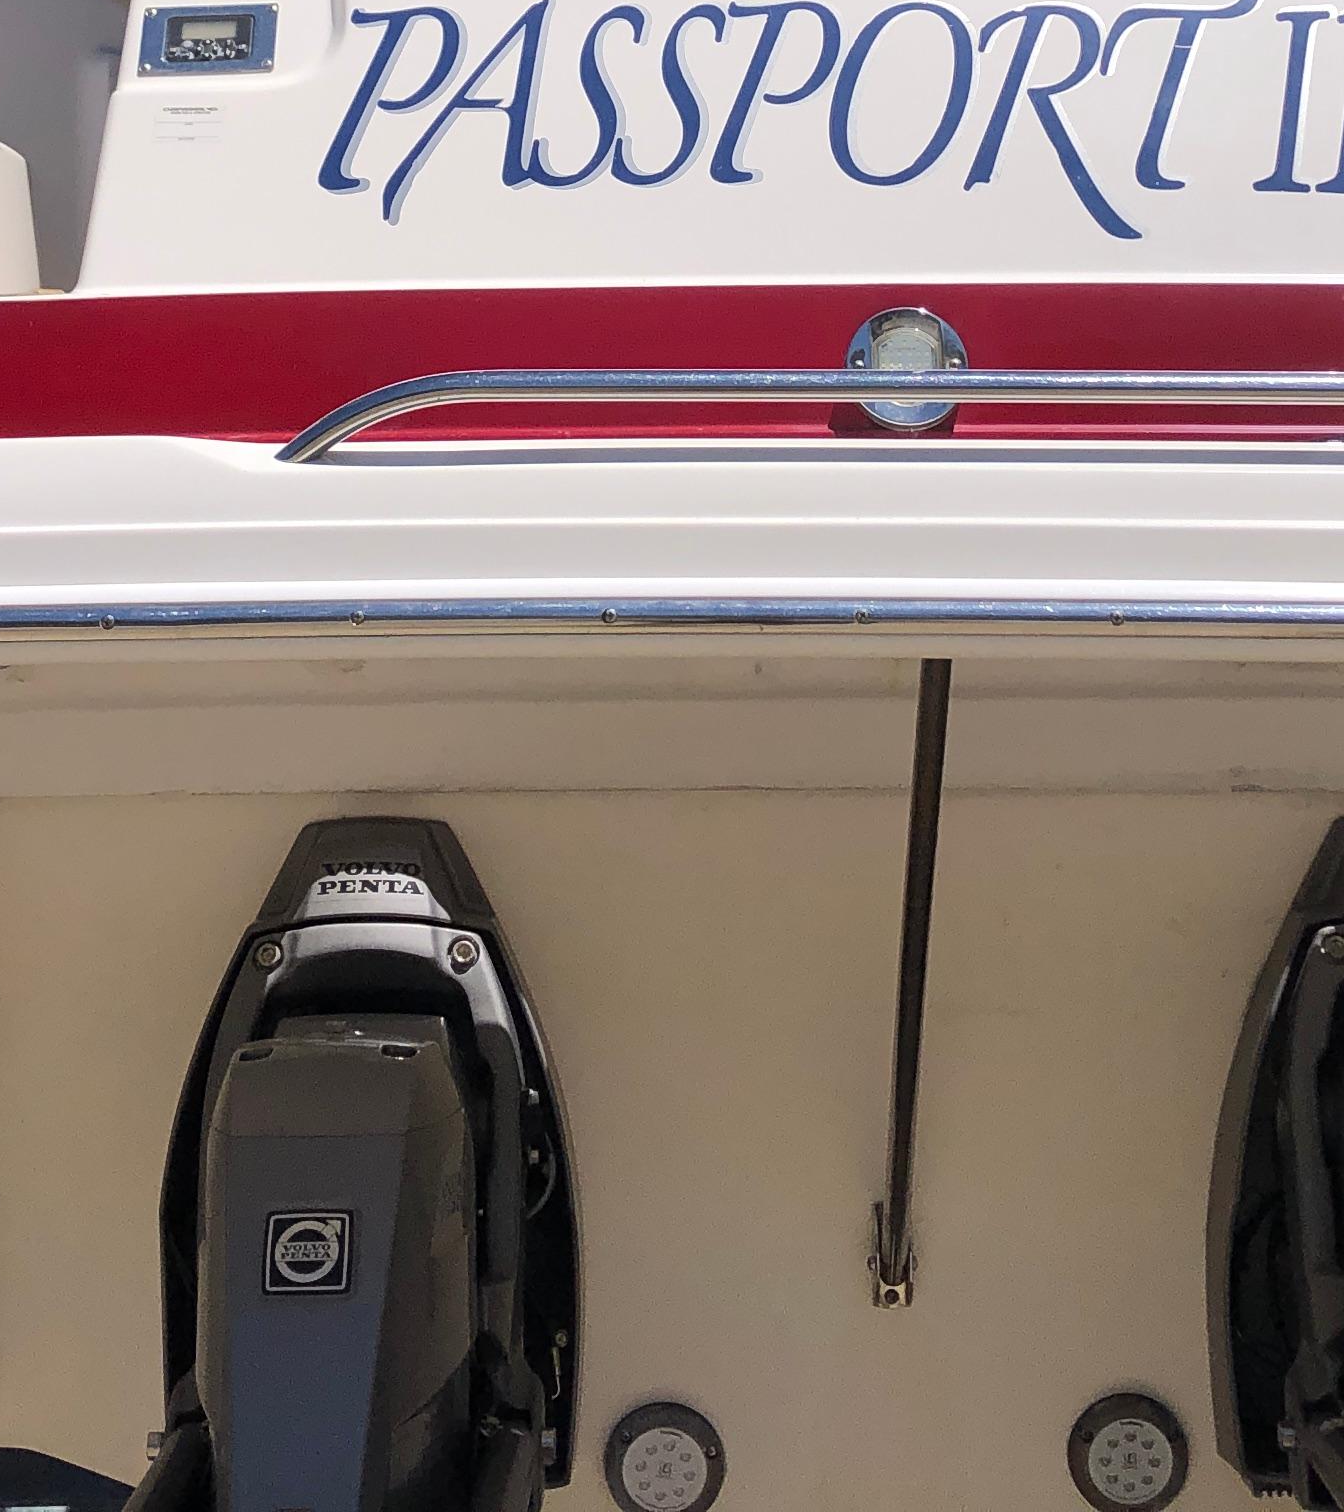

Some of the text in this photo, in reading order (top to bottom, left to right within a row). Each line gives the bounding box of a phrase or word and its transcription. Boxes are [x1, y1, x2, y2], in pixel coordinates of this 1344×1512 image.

[321, 861, 422, 876] VOLVO
[317, 879, 424, 895] PENTA
[282, 1243, 332, 1252] VOLVO
[280, 1251, 332, 1259] PENTA
